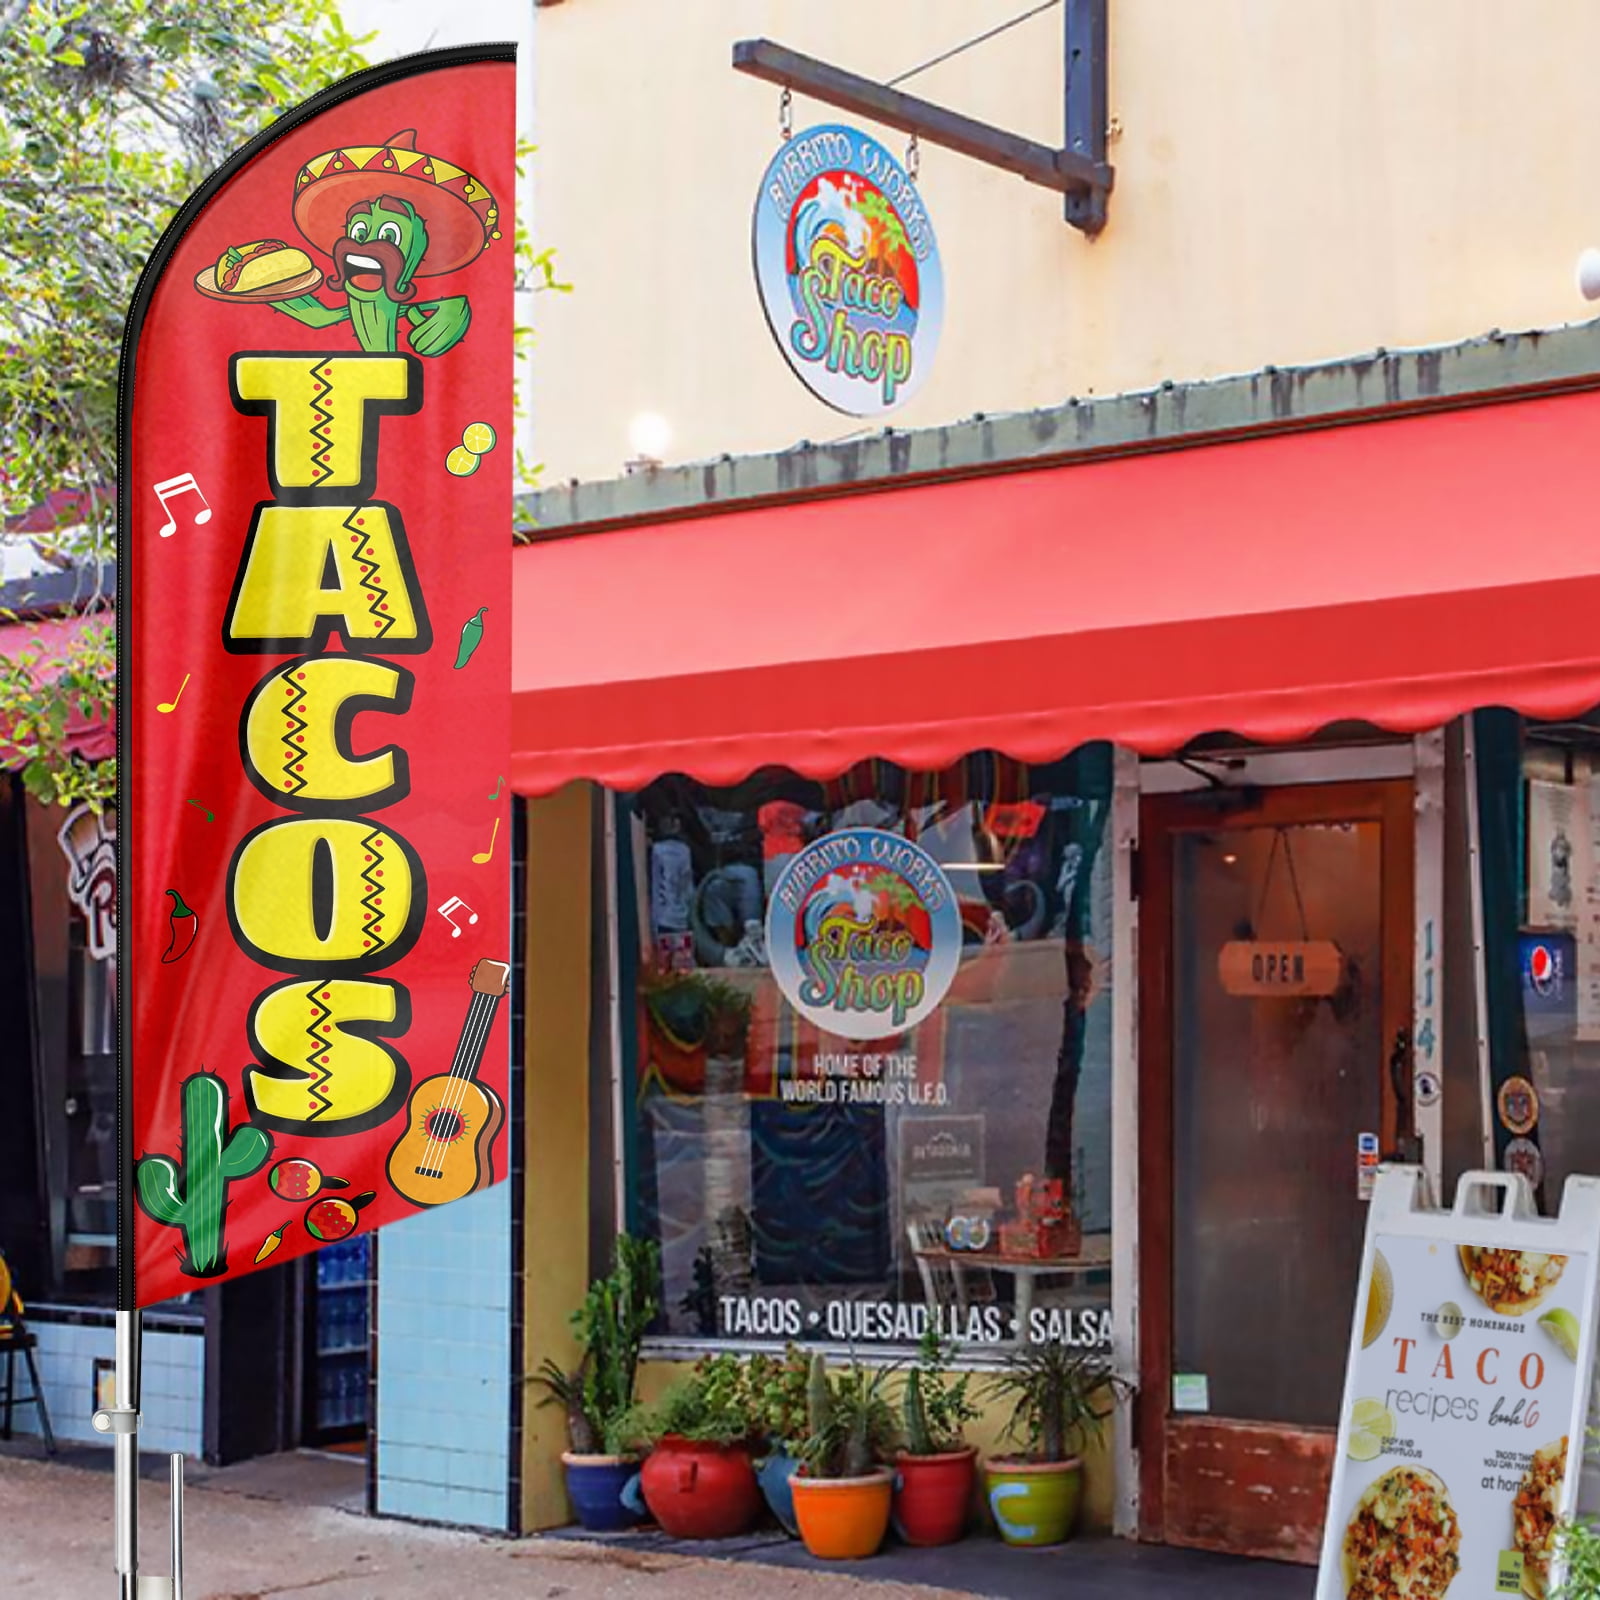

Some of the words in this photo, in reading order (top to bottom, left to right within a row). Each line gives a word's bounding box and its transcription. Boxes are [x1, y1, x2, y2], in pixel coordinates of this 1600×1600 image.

[810, 235, 901, 319] Taco
[790, 265, 912, 405] Shop
[222, 351, 433, 1133] TACOS
[816, 914, 913, 965] Taco
[799, 938, 925, 1027] Shop
[1252, 953, 1304, 984] OPEN
[814, 1054, 858, 1077] HOME
[863, 1055, 883, 1077] OF
[887, 1055, 917, 1078] THE
[781, 1079, 838, 1102] WORLD
[840, 1080, 905, 1104] FAMOUS
[719, 1296, 800, 1335] TACOS
[1421, 1312, 1439, 1323] THE
[1442, 1315, 1466, 1327] BEST
[1469, 1318, 1526, 1334] HOMEMADE
[1393, 1337, 1545, 1390] TACO
[1385, 1387, 1479, 1423] recipes
[1481, 1476, 1495, 1489] at
